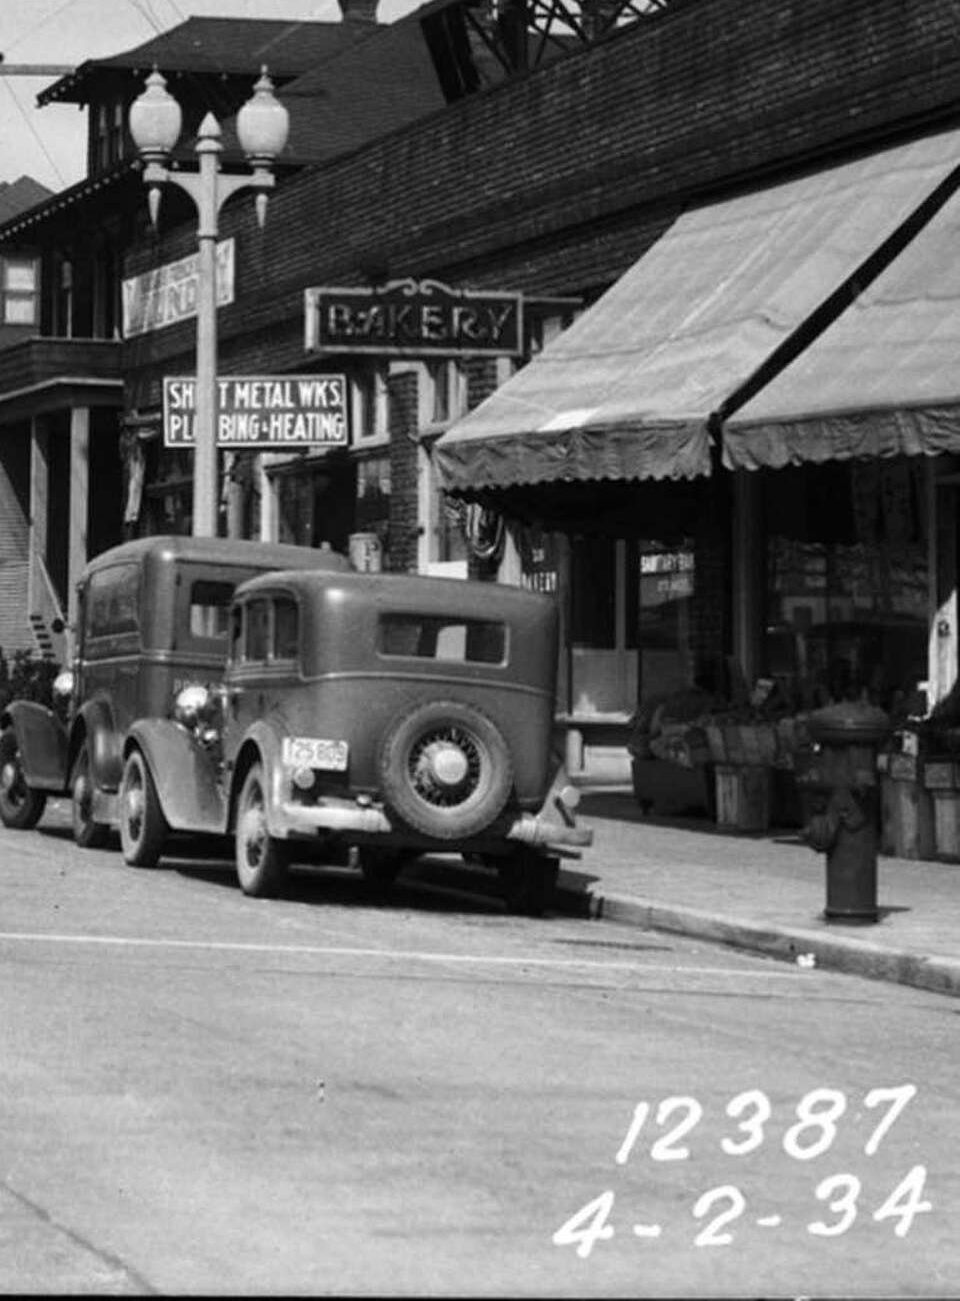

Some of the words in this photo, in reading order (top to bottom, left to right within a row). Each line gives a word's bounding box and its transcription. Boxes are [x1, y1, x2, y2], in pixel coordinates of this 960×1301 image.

[328, 304, 513, 340] BAKERY
[169, 381, 229, 410] SHT
[234, 381, 295, 410] METAL
[169, 413, 260, 441] PLBING
[269, 412, 345, 441] HEATING
